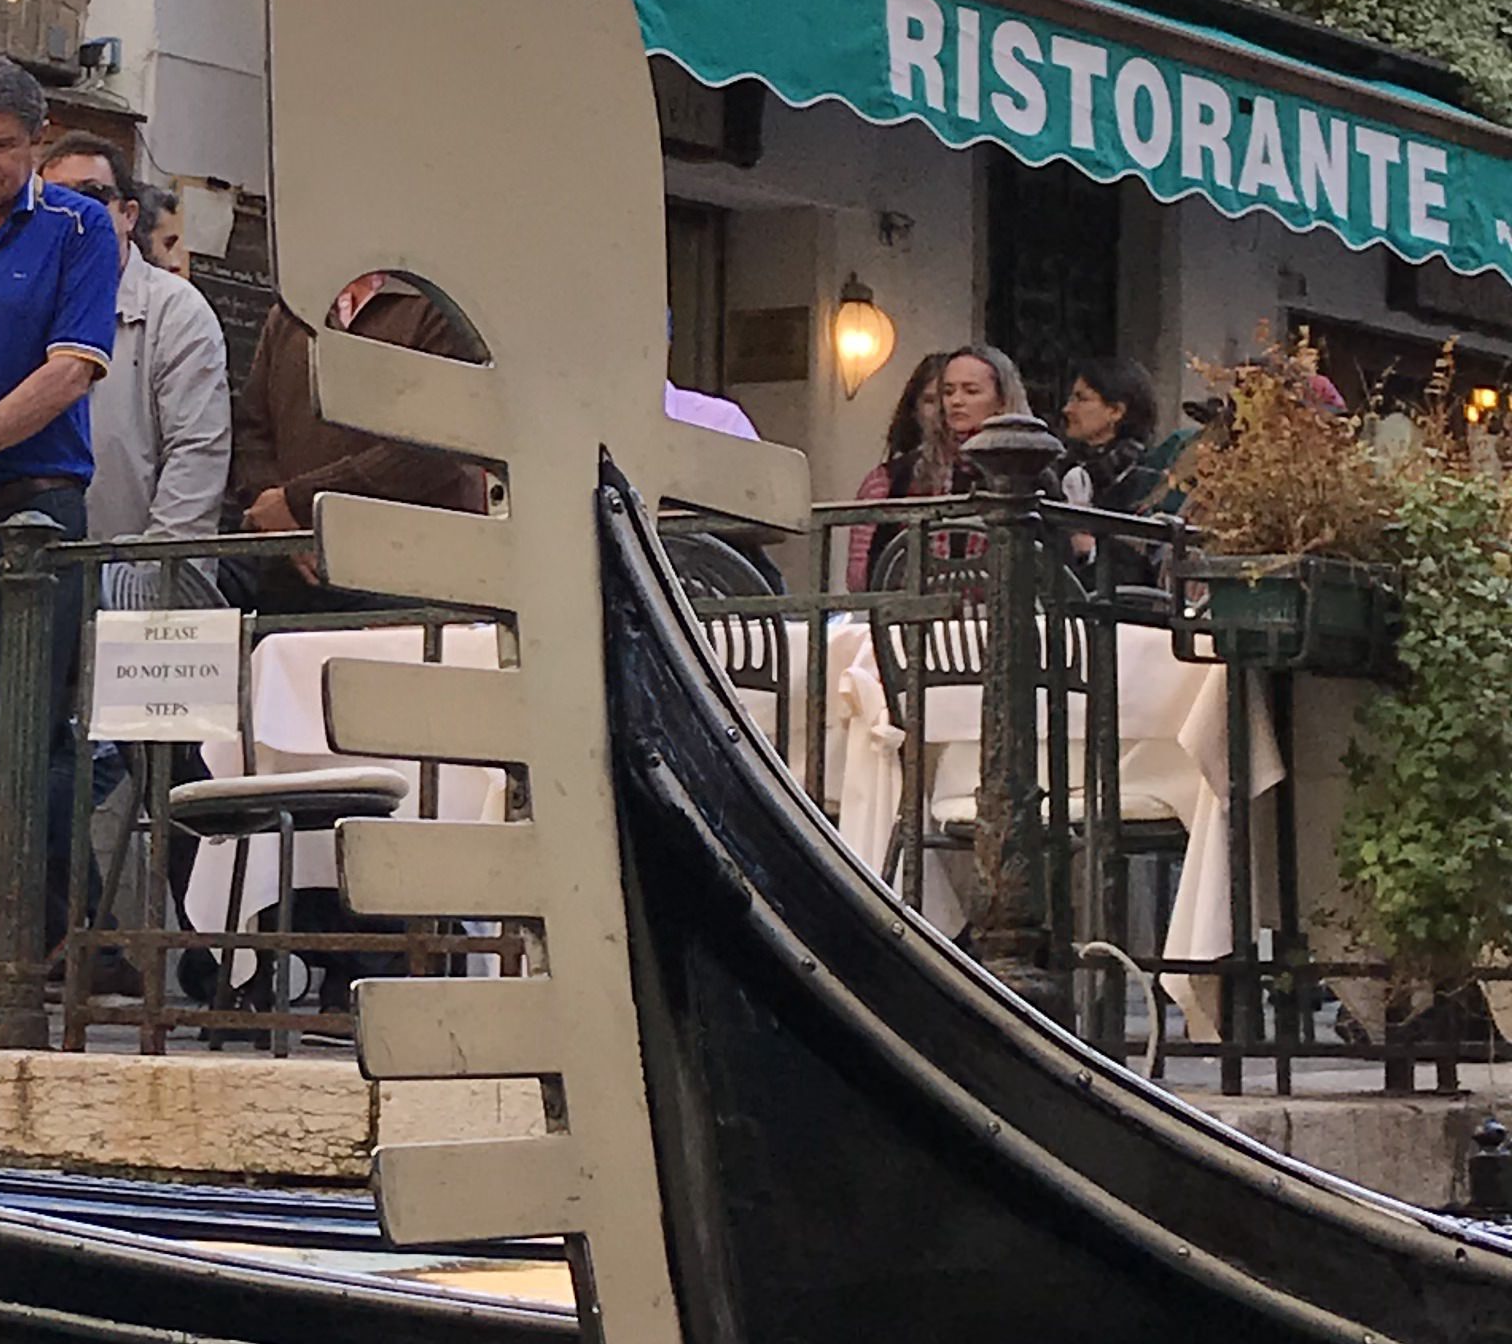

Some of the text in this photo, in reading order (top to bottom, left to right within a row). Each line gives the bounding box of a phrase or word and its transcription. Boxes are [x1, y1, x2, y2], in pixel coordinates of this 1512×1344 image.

[144, 626, 199, 641] PLEASE
[116, 664, 220, 679] DO NOT SIT ON
[145, 702, 189, 717] STEPS
